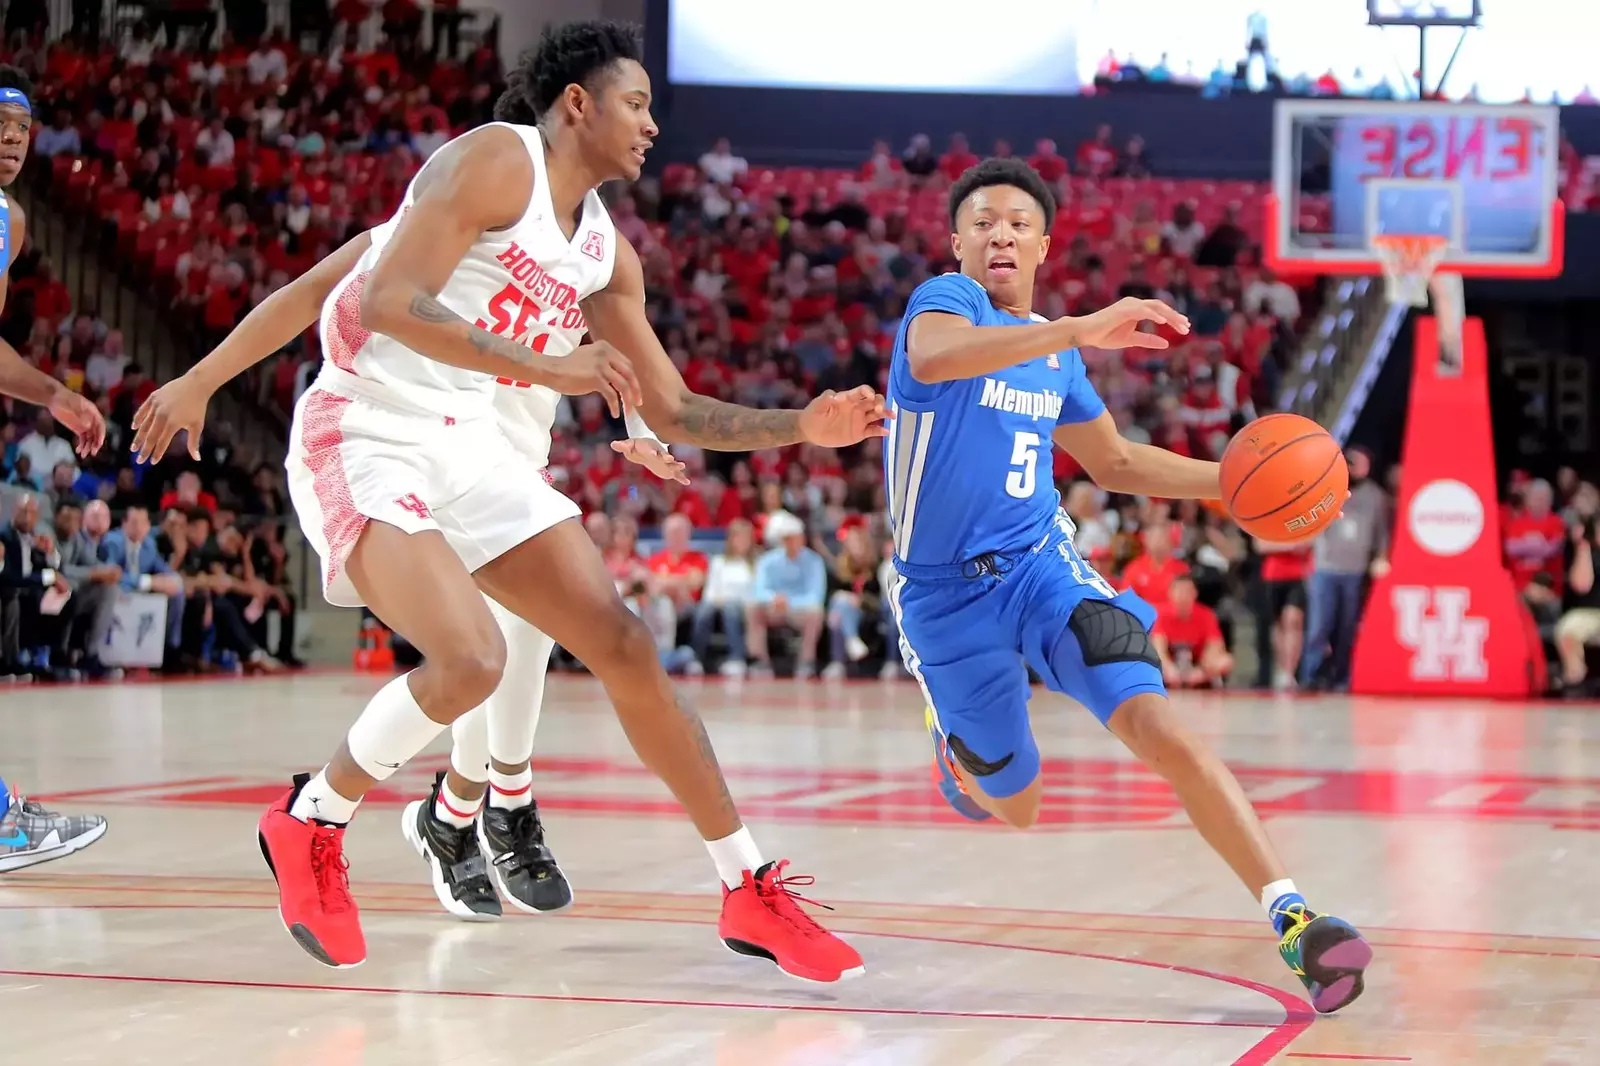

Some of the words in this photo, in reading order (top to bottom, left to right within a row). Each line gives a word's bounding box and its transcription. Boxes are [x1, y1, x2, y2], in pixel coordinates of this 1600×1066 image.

[496, 241, 578, 311] HOUSTON
[978, 377, 1063, 421] Memphis
[1005, 431, 1040, 499] 5
[1391, 585, 1490, 682] UH
